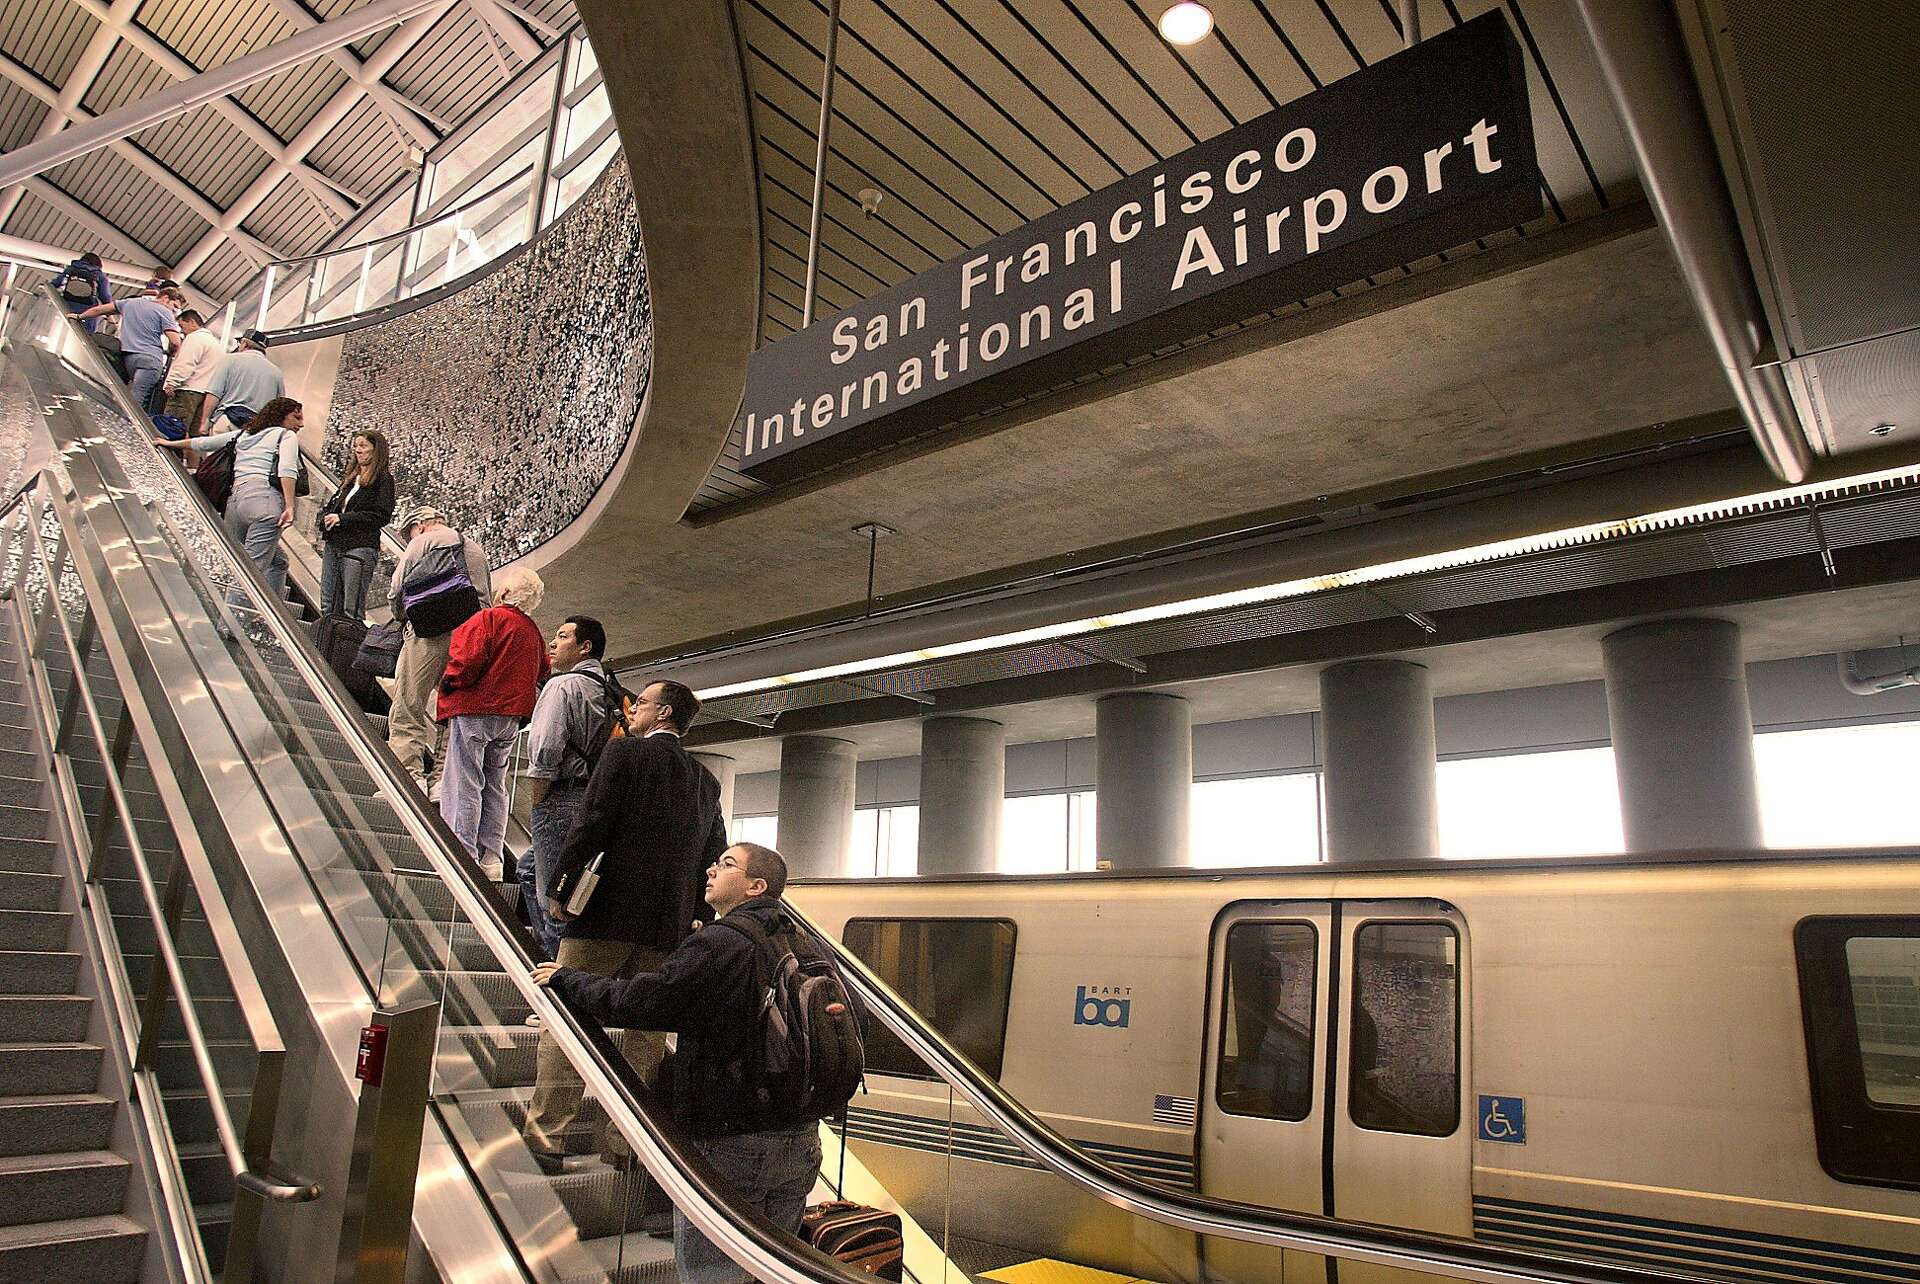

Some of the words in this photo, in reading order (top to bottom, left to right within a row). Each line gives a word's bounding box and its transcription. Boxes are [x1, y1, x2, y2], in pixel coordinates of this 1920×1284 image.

[744, 258, 1123, 458] International
[1169, 118, 1503, 292] Airport
[829, 297, 926, 366] San
[960, 127, 1318, 312] Francisco
[1090, 986, 1132, 996] BART
